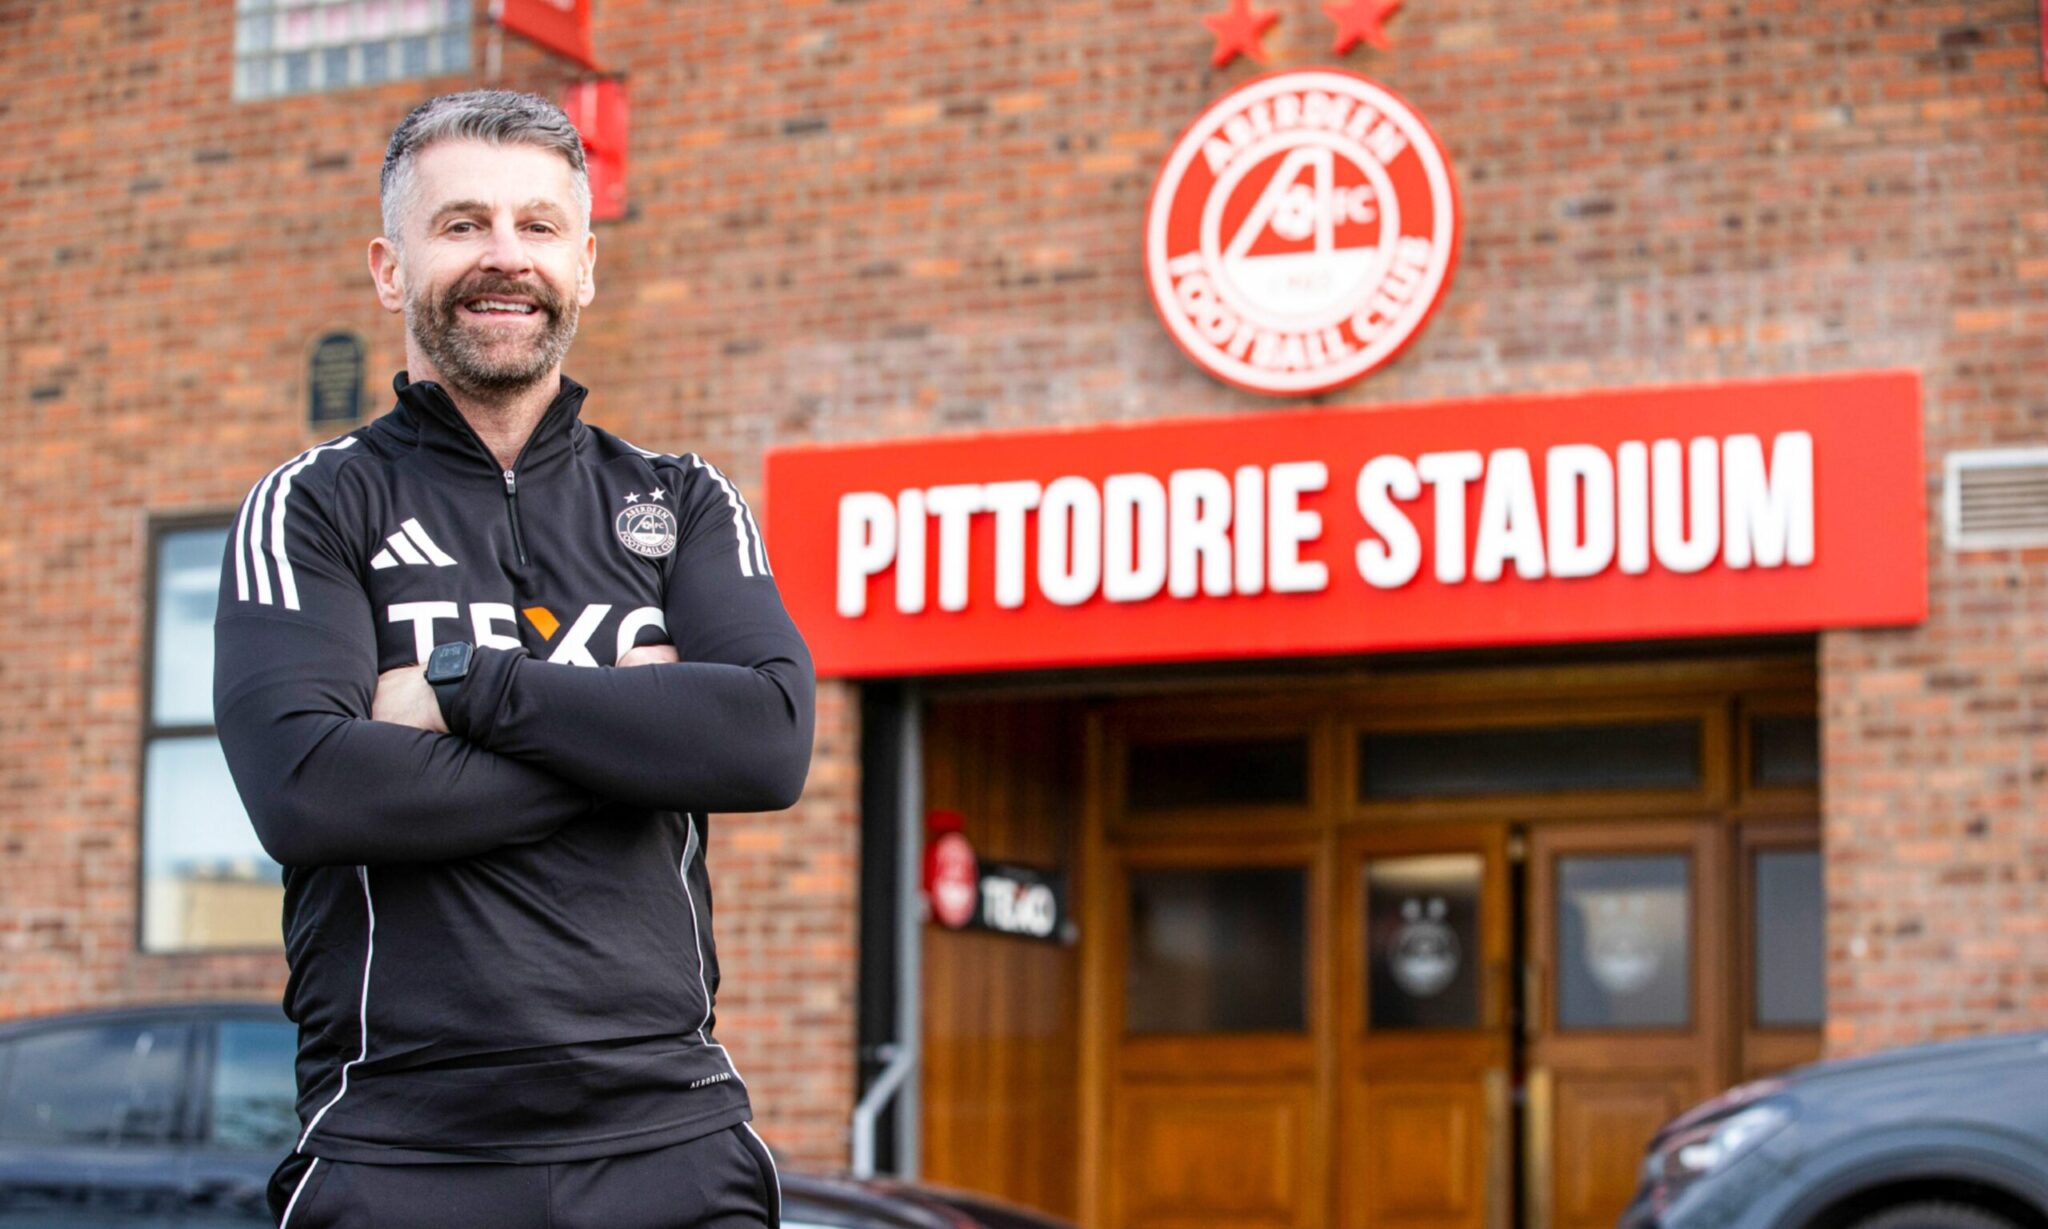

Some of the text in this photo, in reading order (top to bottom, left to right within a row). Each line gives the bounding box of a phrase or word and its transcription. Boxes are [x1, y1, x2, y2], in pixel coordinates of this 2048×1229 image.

[1202, 91, 1409, 178] ABERDEEN
[1168, 235, 1433, 370] FOOTBALL CLUB
[619, 531, 662, 555] FOOTBALL
[625, 506, 670, 520] ABERDEEN
[836, 430, 1815, 618] PITTODRIE STADIUM
